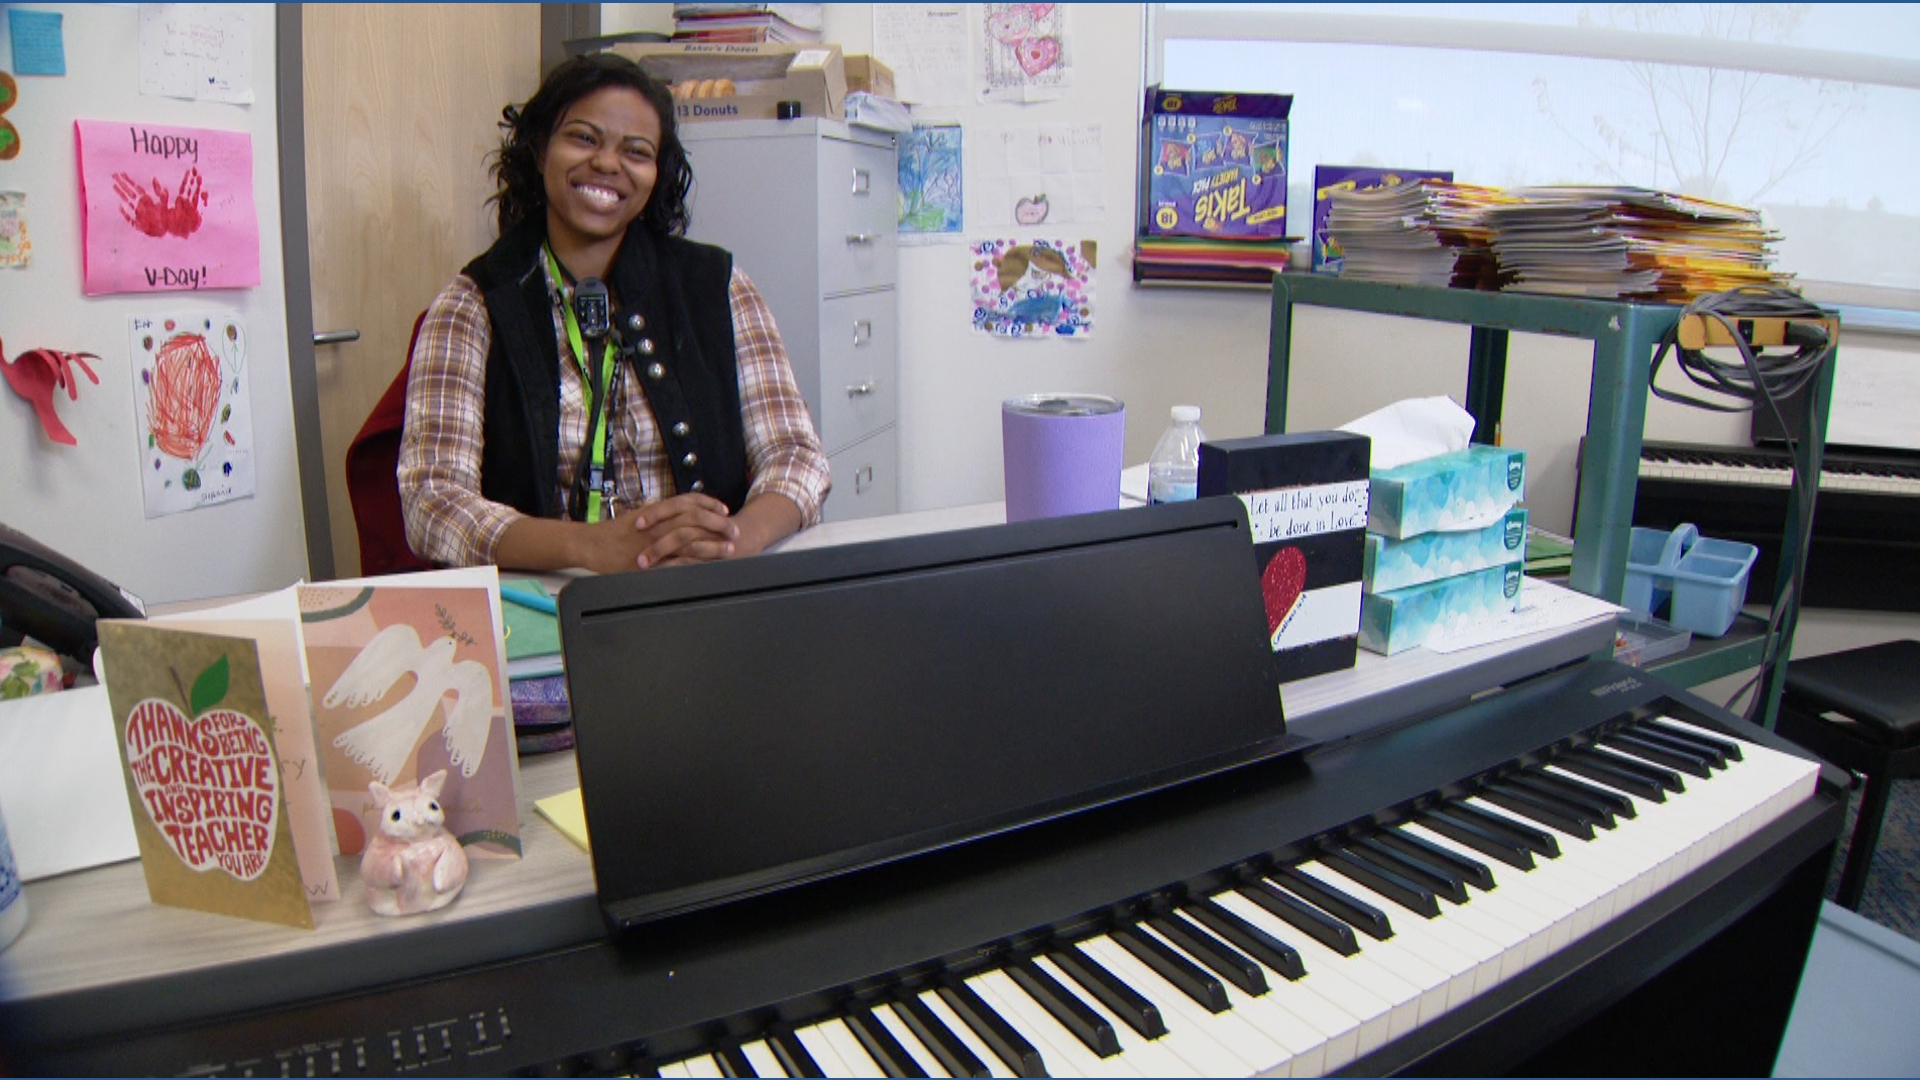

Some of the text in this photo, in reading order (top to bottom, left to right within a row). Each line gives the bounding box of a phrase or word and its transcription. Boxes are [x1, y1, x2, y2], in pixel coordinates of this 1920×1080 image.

[724, 44, 759, 52] Dozen
[677, 103, 738, 118] 13 Donuts
[129, 126, 199, 164] Happy
[1194, 177, 1252, 222] Takis
[1160, 212, 1174, 223] 18
[144, 265, 207, 290] V-Day!
[1274, 492, 1288, 513] all
[1291, 490, 1313, 511] that
[1319, 492, 1338, 511] you
[1269, 517, 1282, 538] be
[1286, 518, 1312, 537] done
[1315, 520, 1327, 533] in
[127, 702, 220, 757] THANKS
[217, 726, 269, 757] BEING
[131, 744, 275, 792] THE CREATIVE
[164, 783, 185, 796] AND
[144, 786, 274, 826] INSPIRING
[163, 819, 270, 866] TEACHER
[215, 852, 243, 877] YOU
